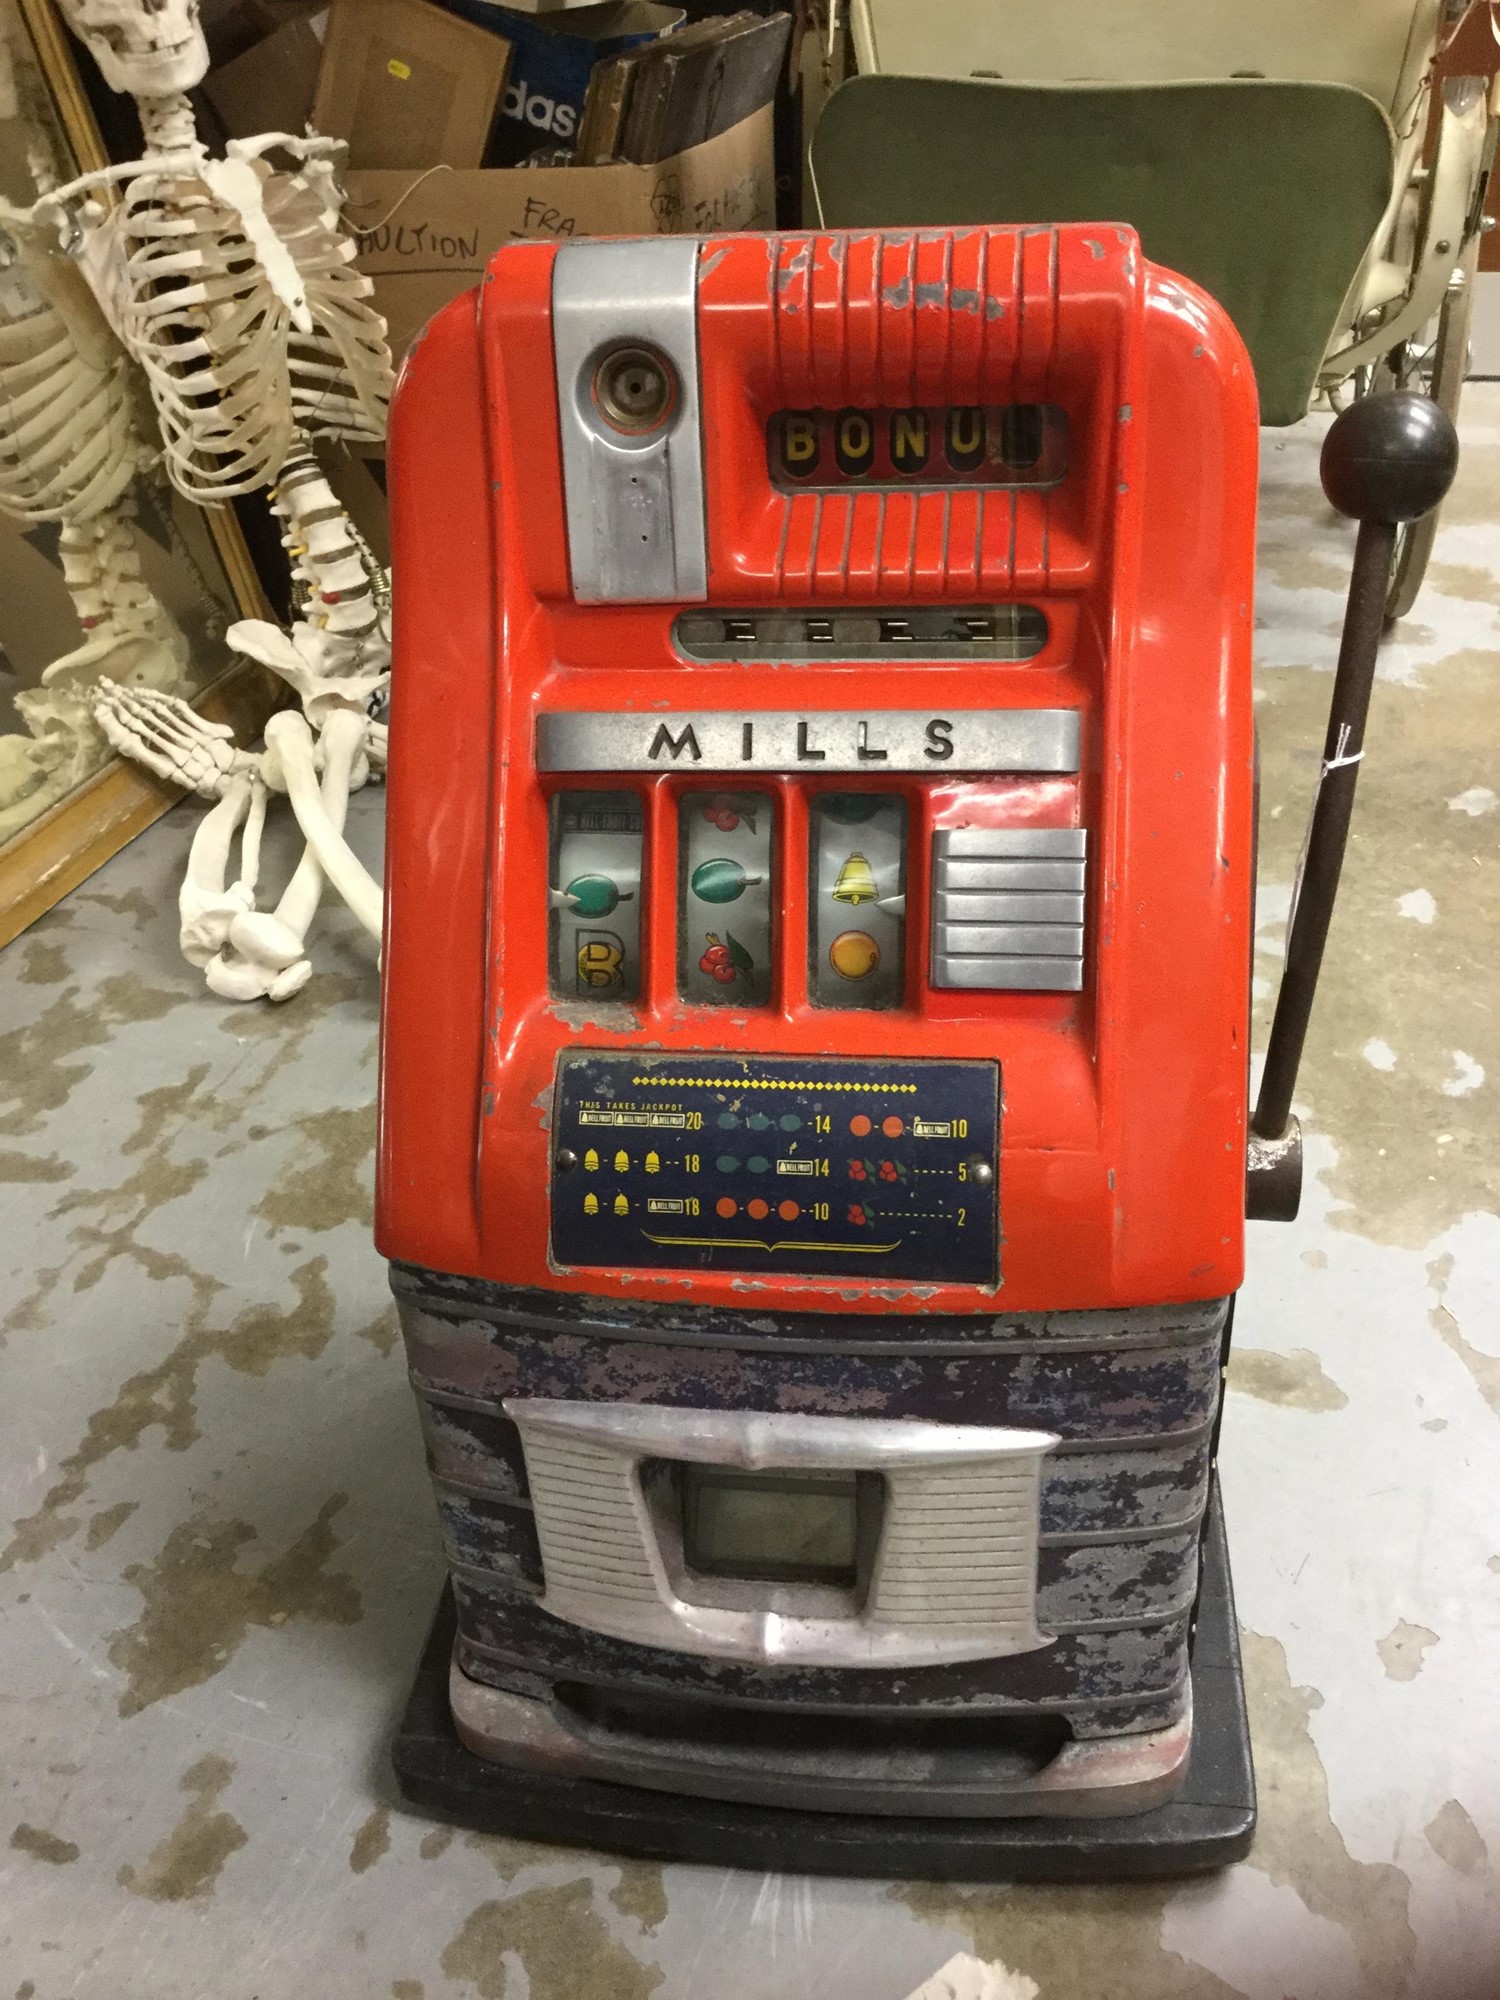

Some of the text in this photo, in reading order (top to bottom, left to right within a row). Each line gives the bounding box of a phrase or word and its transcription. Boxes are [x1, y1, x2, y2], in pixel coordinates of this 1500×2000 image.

[647, 719, 955, 761] MILLS
[579, 1100, 684, 1111] THIS TAKES JACKPOT
[686, 1111, 702, 1130] 20
[815, 1115, 831, 1133] 14
[951, 1119, 967, 1138] 10
[685, 1154, 700, 1173] 18
[786, 1163, 797, 1171] BELL
[814, 1158, 830, 1176] 14
[958, 1163, 966, 1181] 5
[657, 1202, 668, 1210] BELL
[685, 1198, 700, 1216] 18
[814, 1202, 829, 1220] 10
[957, 1208, 966, 1226] 2
